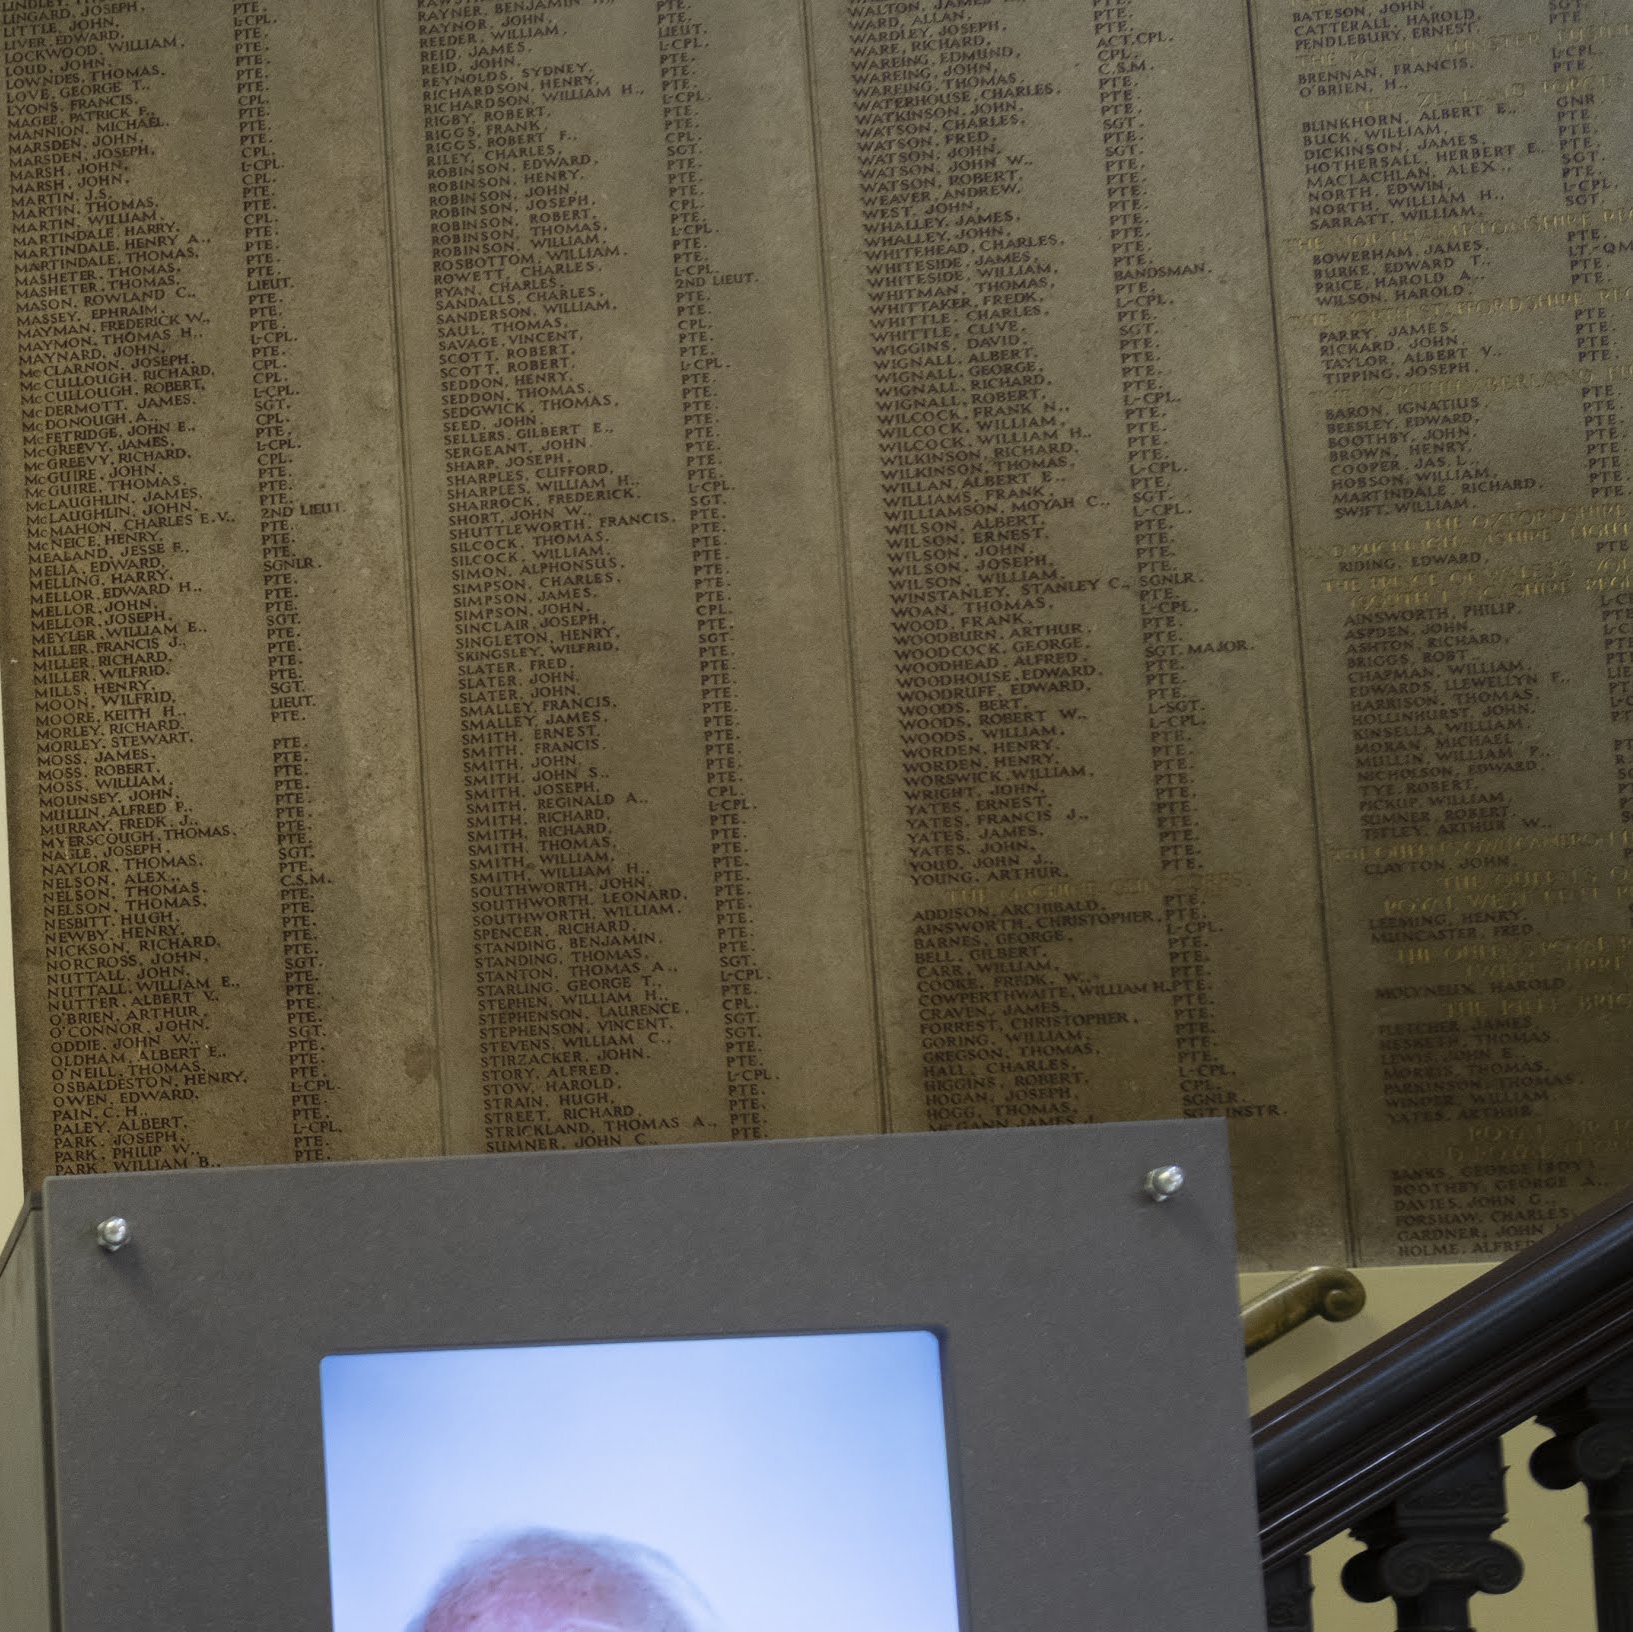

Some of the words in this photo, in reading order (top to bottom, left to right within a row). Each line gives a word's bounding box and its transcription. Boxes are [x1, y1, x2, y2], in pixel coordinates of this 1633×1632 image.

[242, 146, 275, 160] CPL.
[243, 185, 276, 199] PTE.
[244, 213, 278, 226] CPL.
[245, 239, 279, 253] PTE.
[246, 252, 280, 266] PTE.
[1114, 265, 1212, 282] BANDSMAN.
[84, 289, 165, 308] ROWLAND
[247, 277, 294, 293] LIEUT.
[1115, 282, 1155, 296] PTE.
[249, 292, 282, 305] PTE.
[1117, 309, 1156, 323] PTE.
[1119, 323, 1158, 337] SGT.
[680, 357, 730, 373] L-CPL.
[1121, 351, 1160, 365] PTE.
[682, 385, 717, 400] PTE.
[685, 426, 719, 440] PTE.
[685, 440, 720, 453] PTE.
[686, 453, 722, 467] PTE.
[688, 479, 734, 494] L-CPL.
[710, 813, 745, 827] PTE.
[278, 846, 315, 862] SGT.
[280, 873, 334, 889] C.S.M.
[714, 884, 751, 897] PTE.
[716, 898, 752, 911] PTE.
[282, 915, 316, 929] PTE.
[282, 928, 317, 942] PTE.
[717, 926, 753, 939] PTE.
[284, 943, 318, 956] PTE.
